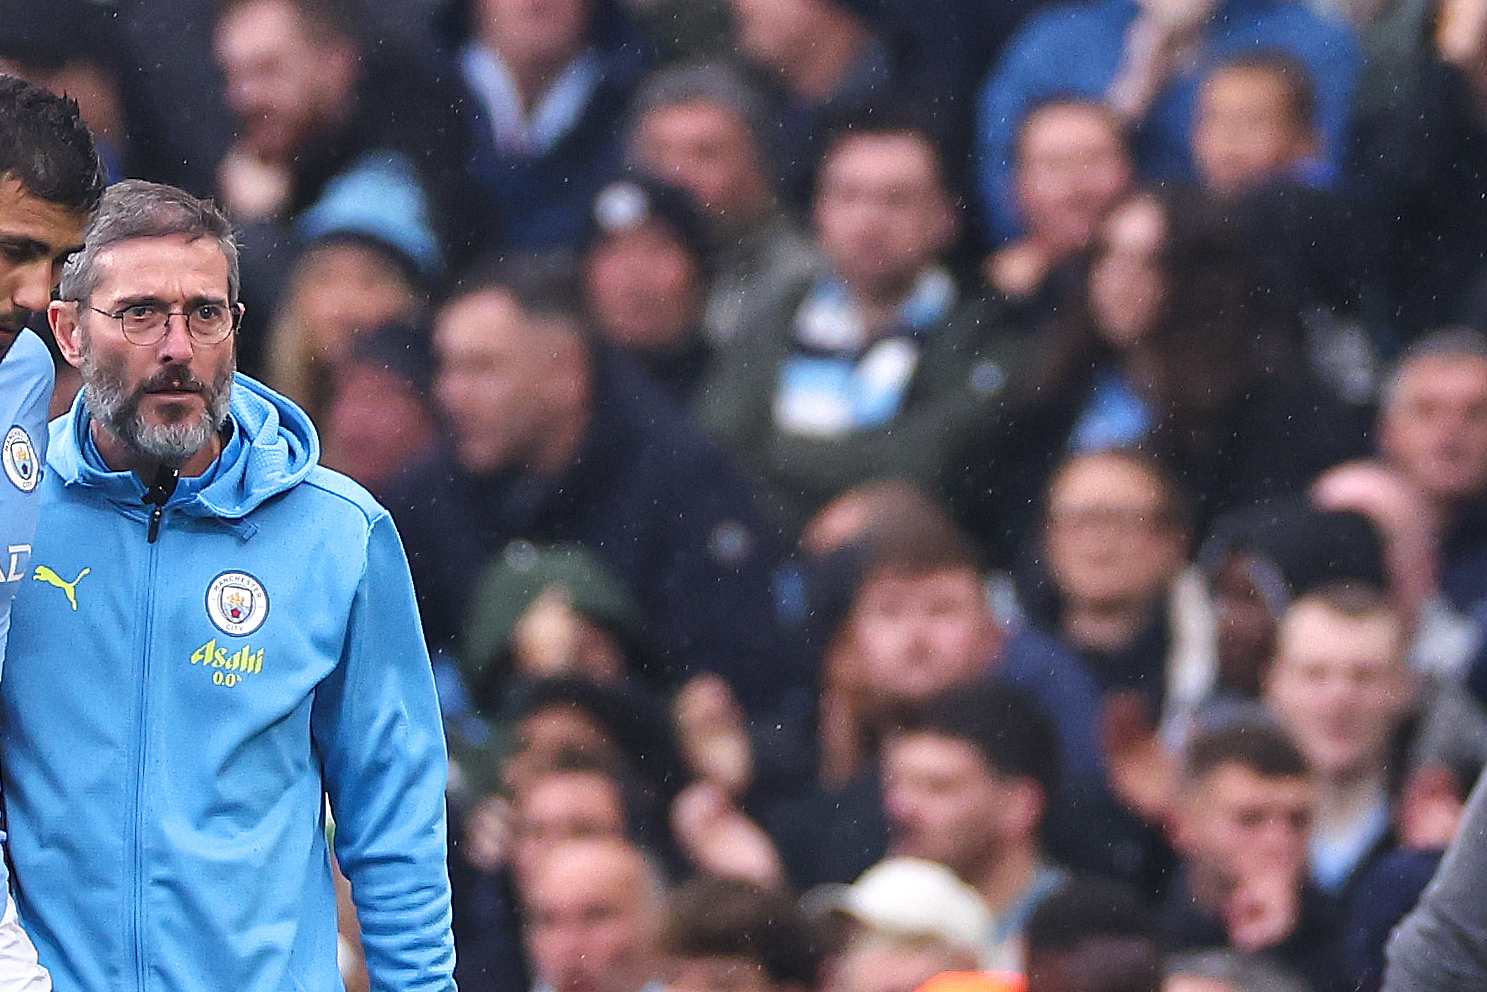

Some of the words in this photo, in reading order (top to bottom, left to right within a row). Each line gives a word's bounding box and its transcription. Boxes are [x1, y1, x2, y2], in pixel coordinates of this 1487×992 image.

[213, 575, 262, 599] MANCHESTER
[225, 623, 244, 632] CITY
[190, 638, 265, 675] Asahi
